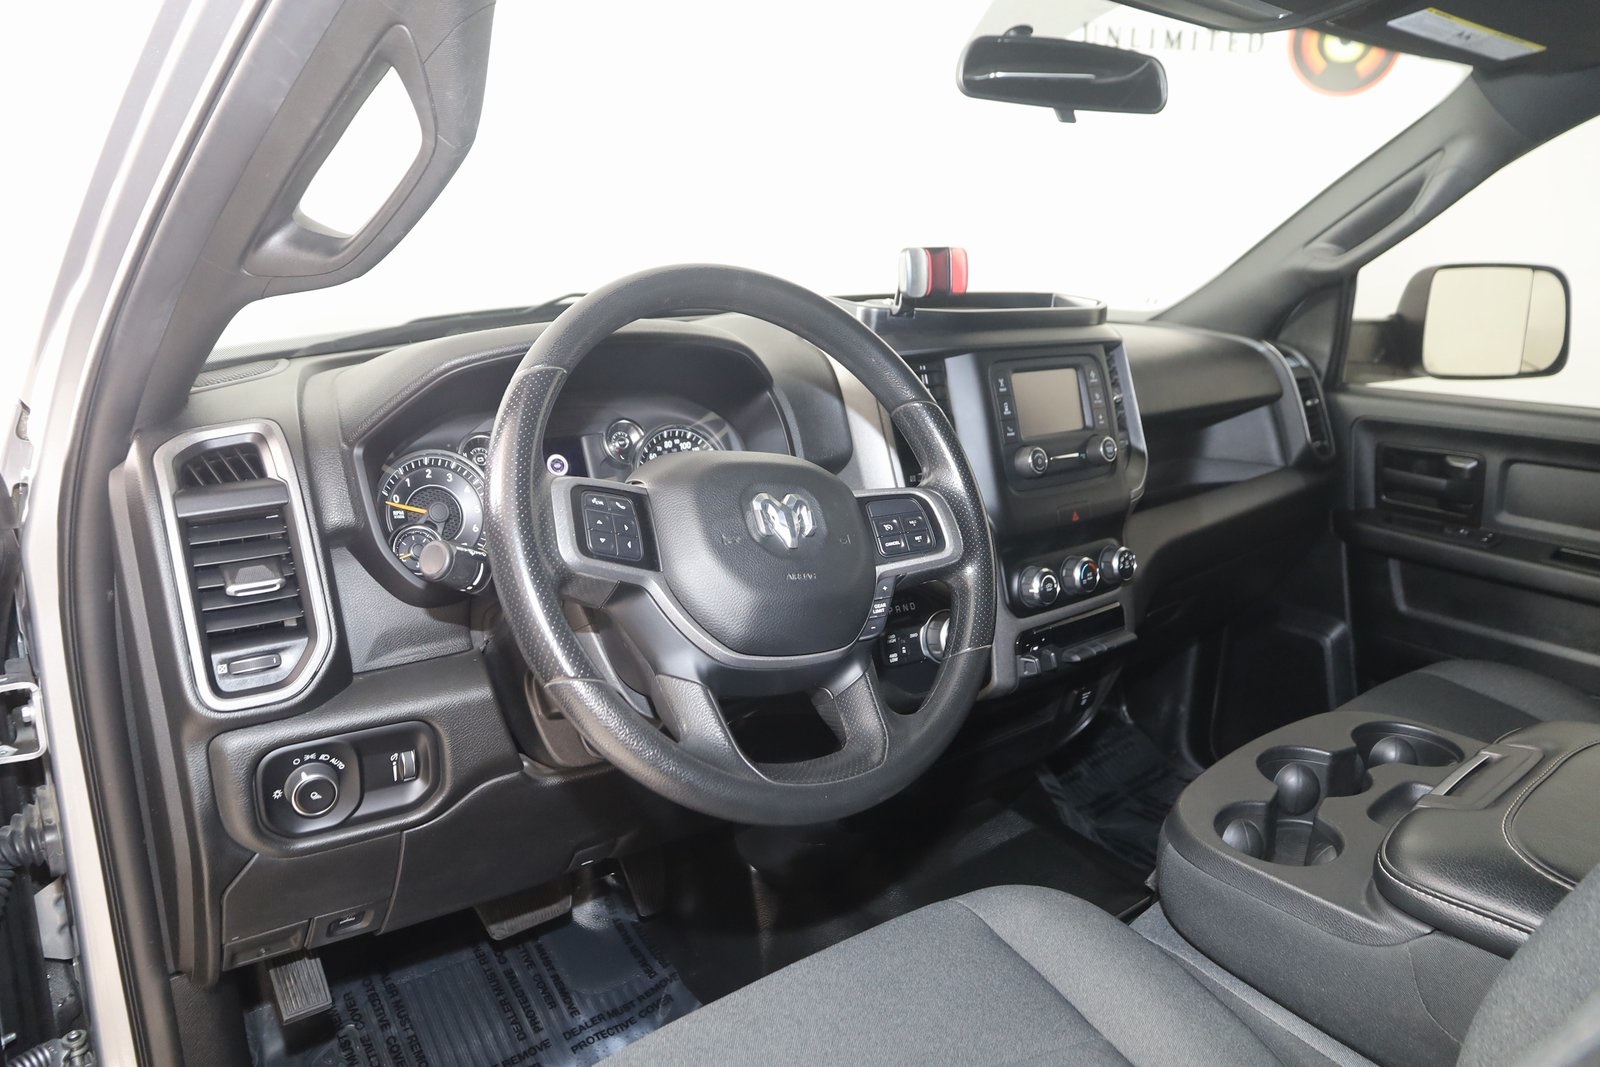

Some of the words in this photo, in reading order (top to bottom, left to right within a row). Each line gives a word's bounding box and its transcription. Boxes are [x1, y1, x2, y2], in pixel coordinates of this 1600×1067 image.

[425, 468, 433, 479] 2
[446, 472, 454, 482] 3
[472, 523, 480, 532] 6
[329, 757, 346, 770] AUTO
[502, 967, 545, 1035] PROTECTIVE
[532, 973, 557, 1010] COVER
[550, 971, 581, 1018] REMOVE
[500, 999, 528, 1042] DEALER
[562, 1012, 608, 1041] DEALER
[605, 998, 638, 1022] MUST
[570, 1015, 638, 1056] PROTECTIVE
